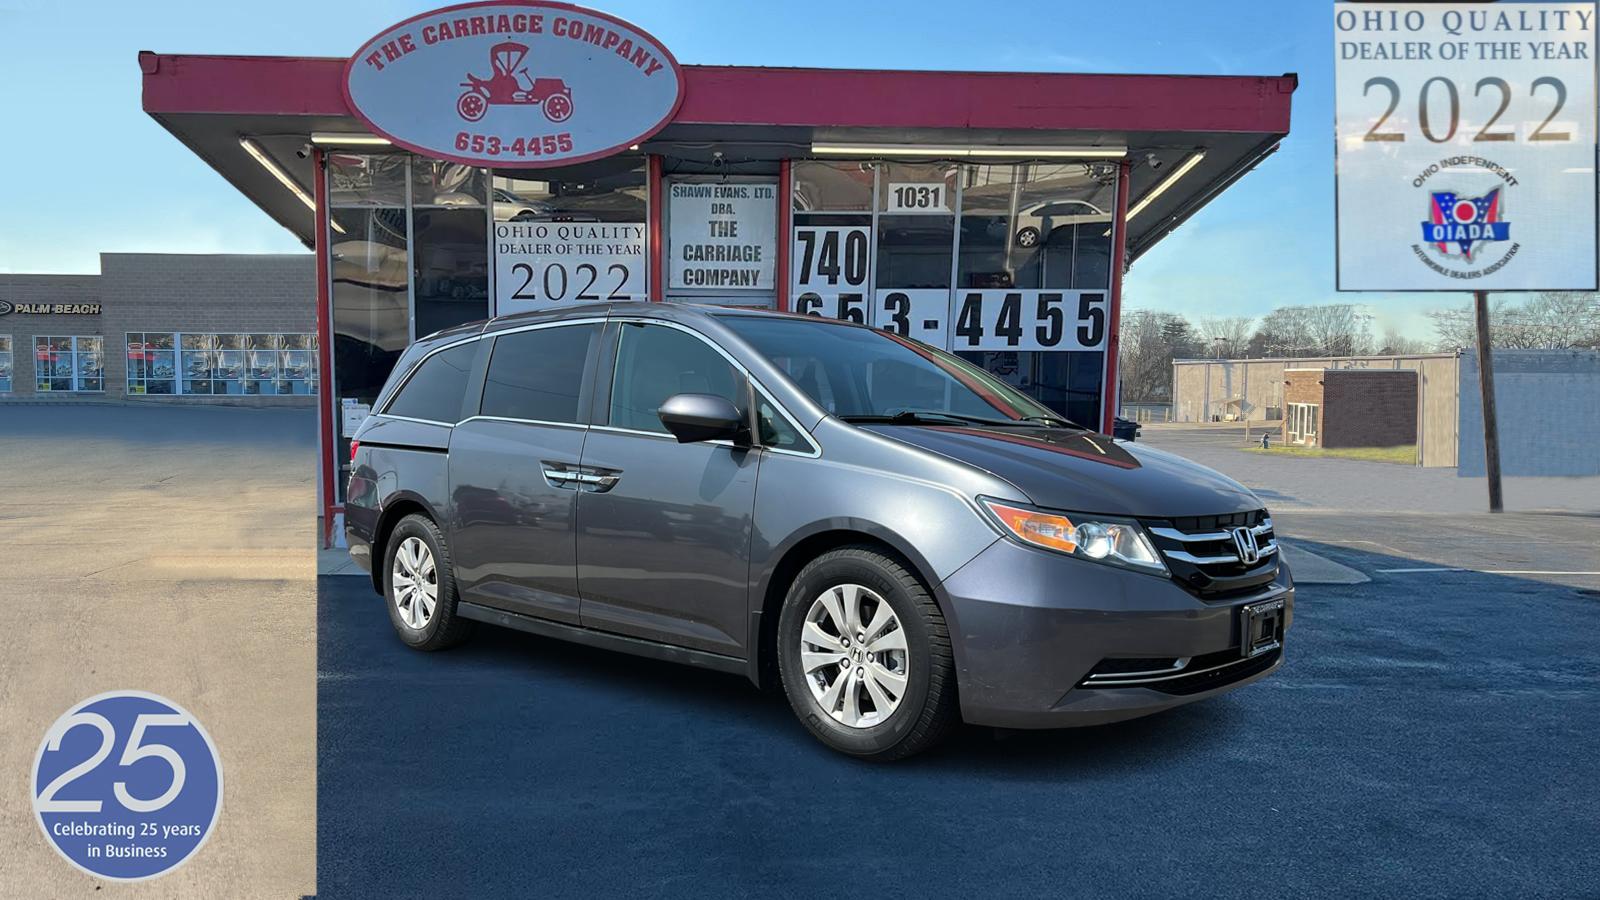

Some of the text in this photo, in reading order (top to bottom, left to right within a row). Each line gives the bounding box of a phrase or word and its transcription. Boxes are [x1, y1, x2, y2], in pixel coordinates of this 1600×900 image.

[1336, 10, 1593, 36] OHIO QUALITY
[365, 14, 664, 77] THE CARRIAGE COMPANY
[1340, 41, 1589, 60] DEALER OF THE YEAR
[1362, 76, 1570, 143] 2022
[454, 131, 573, 156] 653-4455
[1412, 156, 1519, 188] OHIO INDEPENDENT
[672, 185, 712, 199] SHAWN
[754, 186, 774, 200] LTD.
[894, 186, 940, 208] 1031
[711, 203, 735, 215] DBA.
[497, 225, 644, 241] OHIO QUALITY
[708, 220, 737, 238] THE
[1432, 224, 1495, 240] OIADA
[499, 243, 641, 255] DEALER OF THE YEAR
[683, 244, 762, 262] CARRIAGE
[797, 230, 868, 286] 740
[1411, 242, 1521, 279] AUTOMOBILE DEALERS ASSOCIATION
[511, 263, 631, 301] 2022
[683, 268, 760, 287] COMPANY
[14, 303, 100, 314] PALM BEACH
